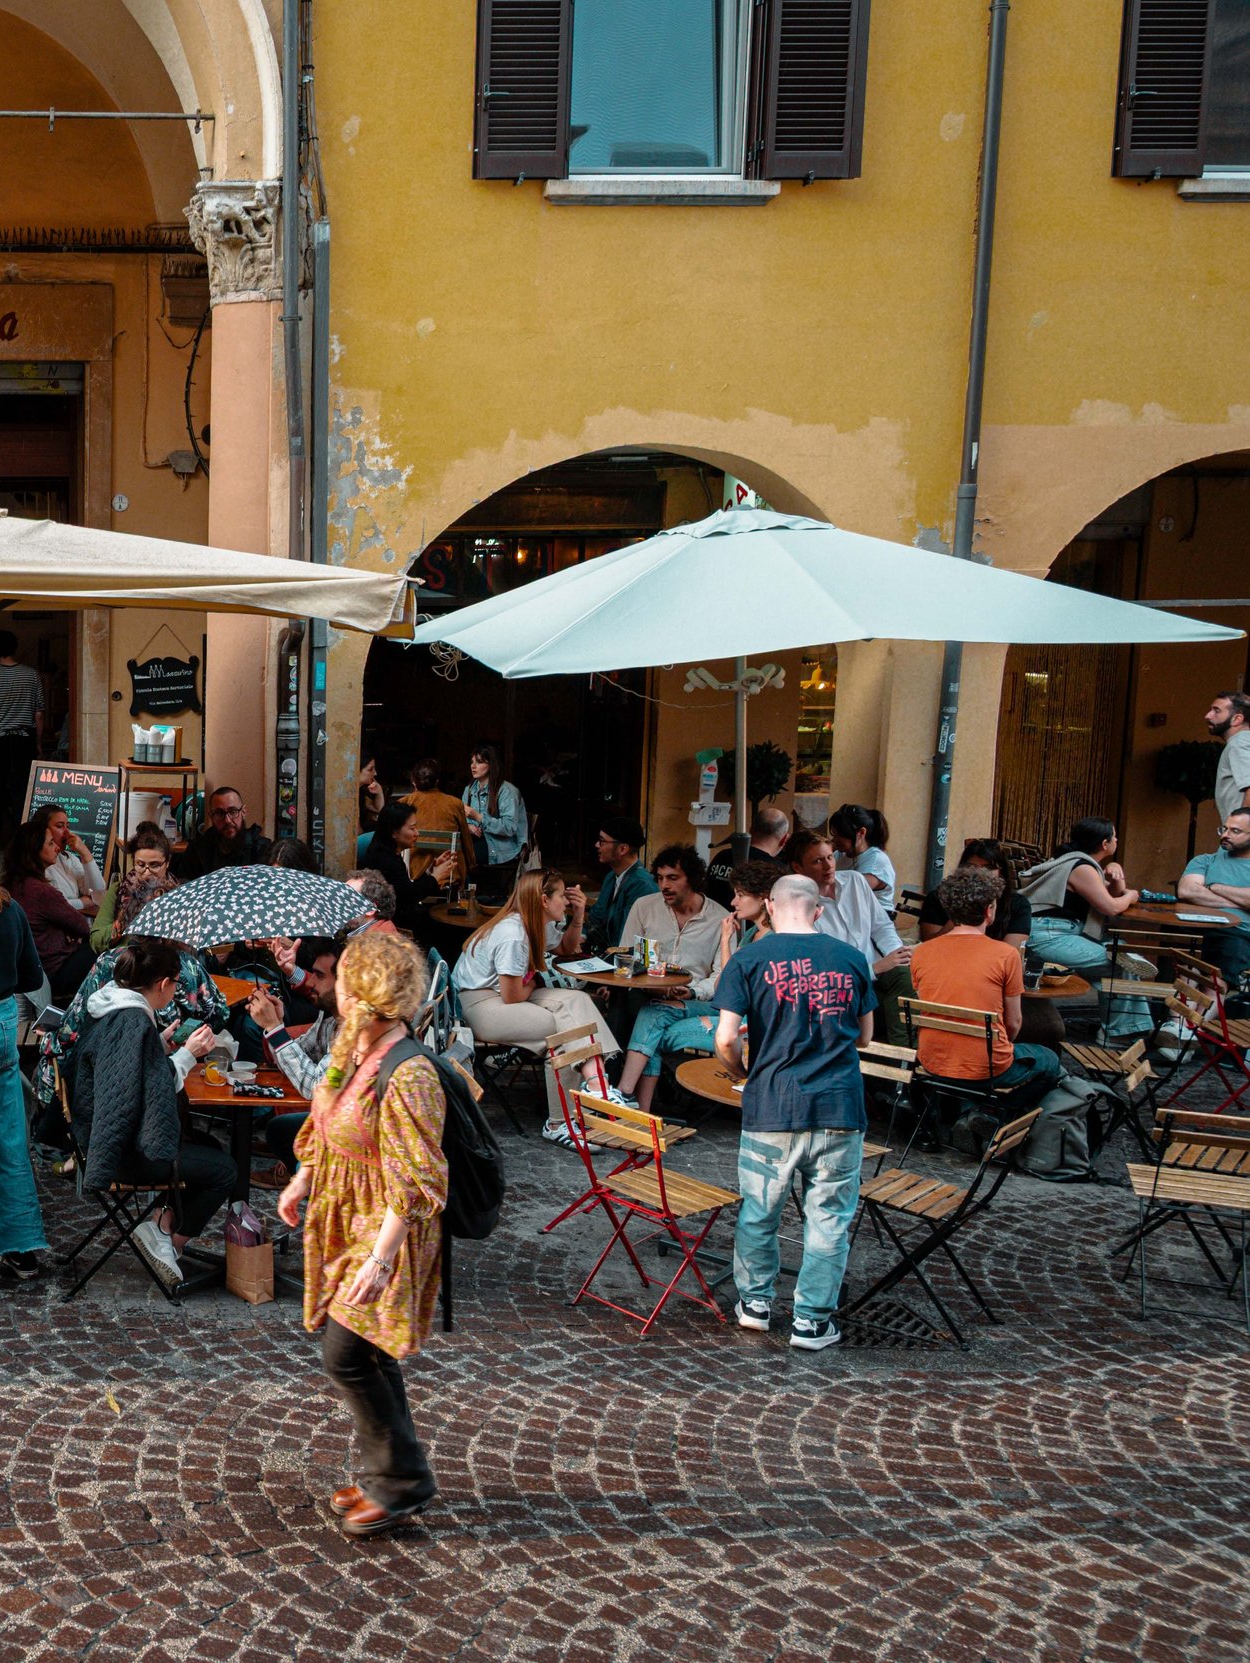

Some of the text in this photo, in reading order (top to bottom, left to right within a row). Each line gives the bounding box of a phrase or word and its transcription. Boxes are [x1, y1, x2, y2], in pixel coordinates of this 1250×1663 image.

[62, 772, 103, 787] MENU
[764, 958, 812, 984] JE NE
[775, 971, 853, 1003] REGRETTE
[808, 989, 854, 1010] RIEN!
